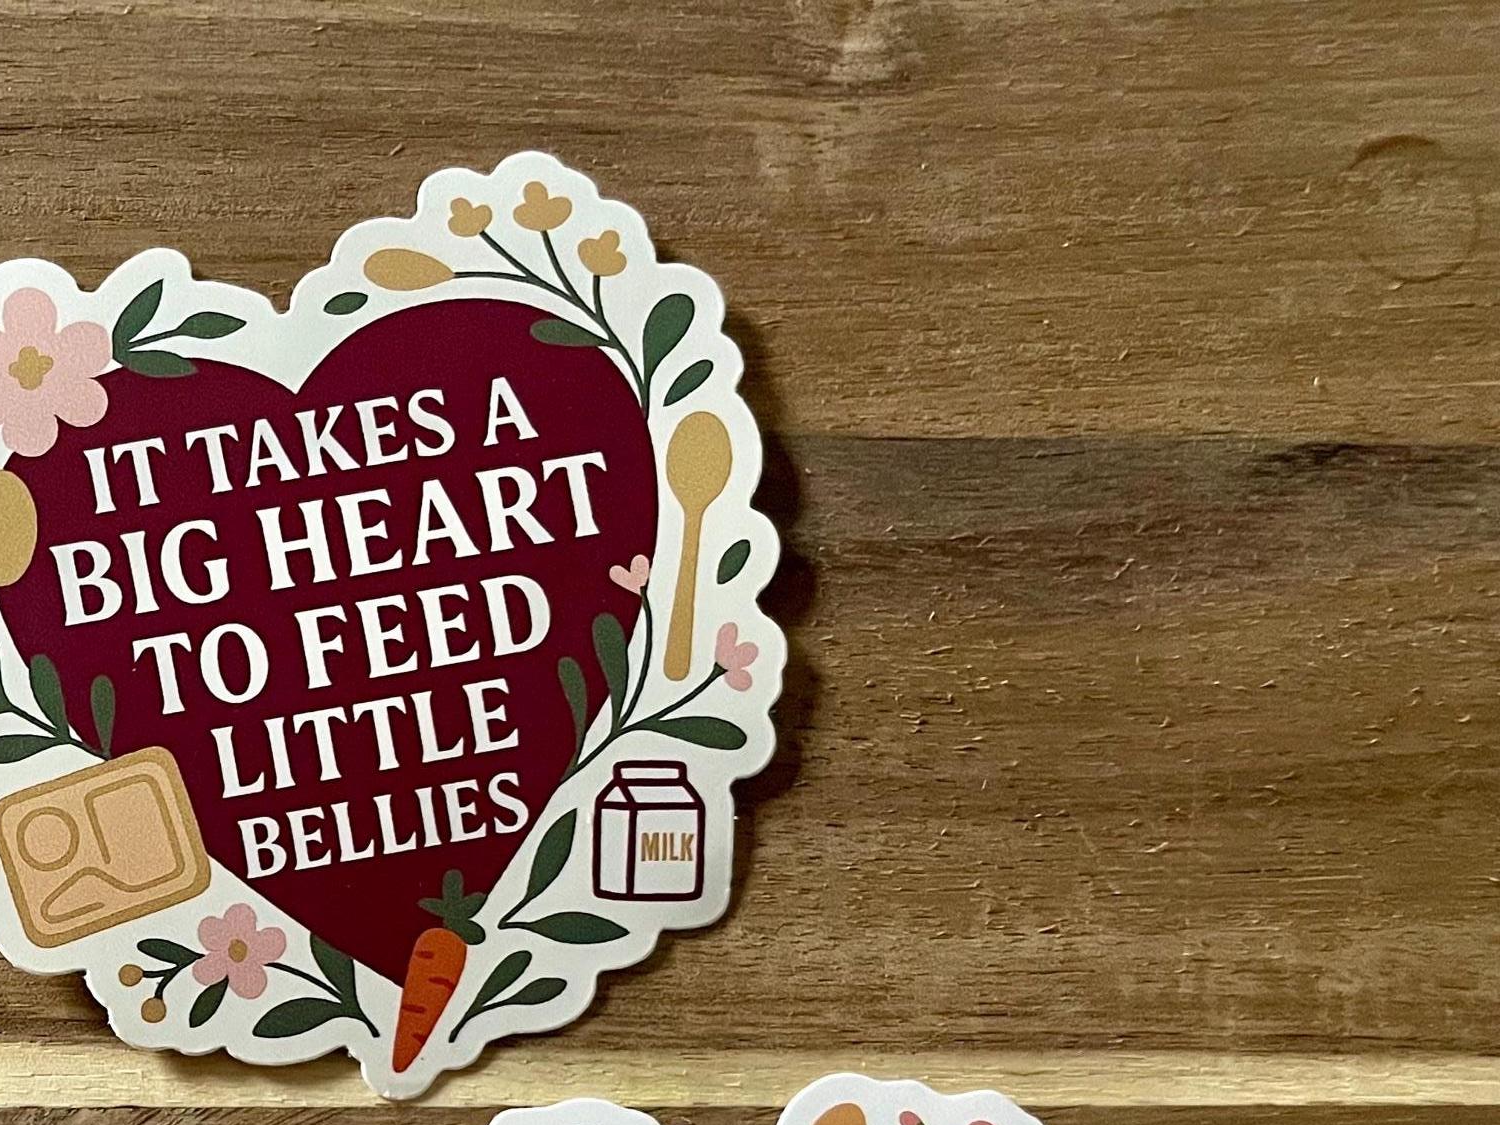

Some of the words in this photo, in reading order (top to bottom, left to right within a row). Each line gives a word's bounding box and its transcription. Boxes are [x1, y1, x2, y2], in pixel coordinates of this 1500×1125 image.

[83, 437, 167, 514] IT
[186, 390, 455, 494] TAKES
[483, 376, 538, 446] A
[49, 519, 230, 627] BIG
[255, 452, 607, 591] HEART
[132, 622, 269, 715] TO
[294, 574, 551, 689] FEED
[210, 678, 520, 799] LITTLE
[237, 771, 530, 879] BELLIES
[641, 832, 694, 862] MILK
